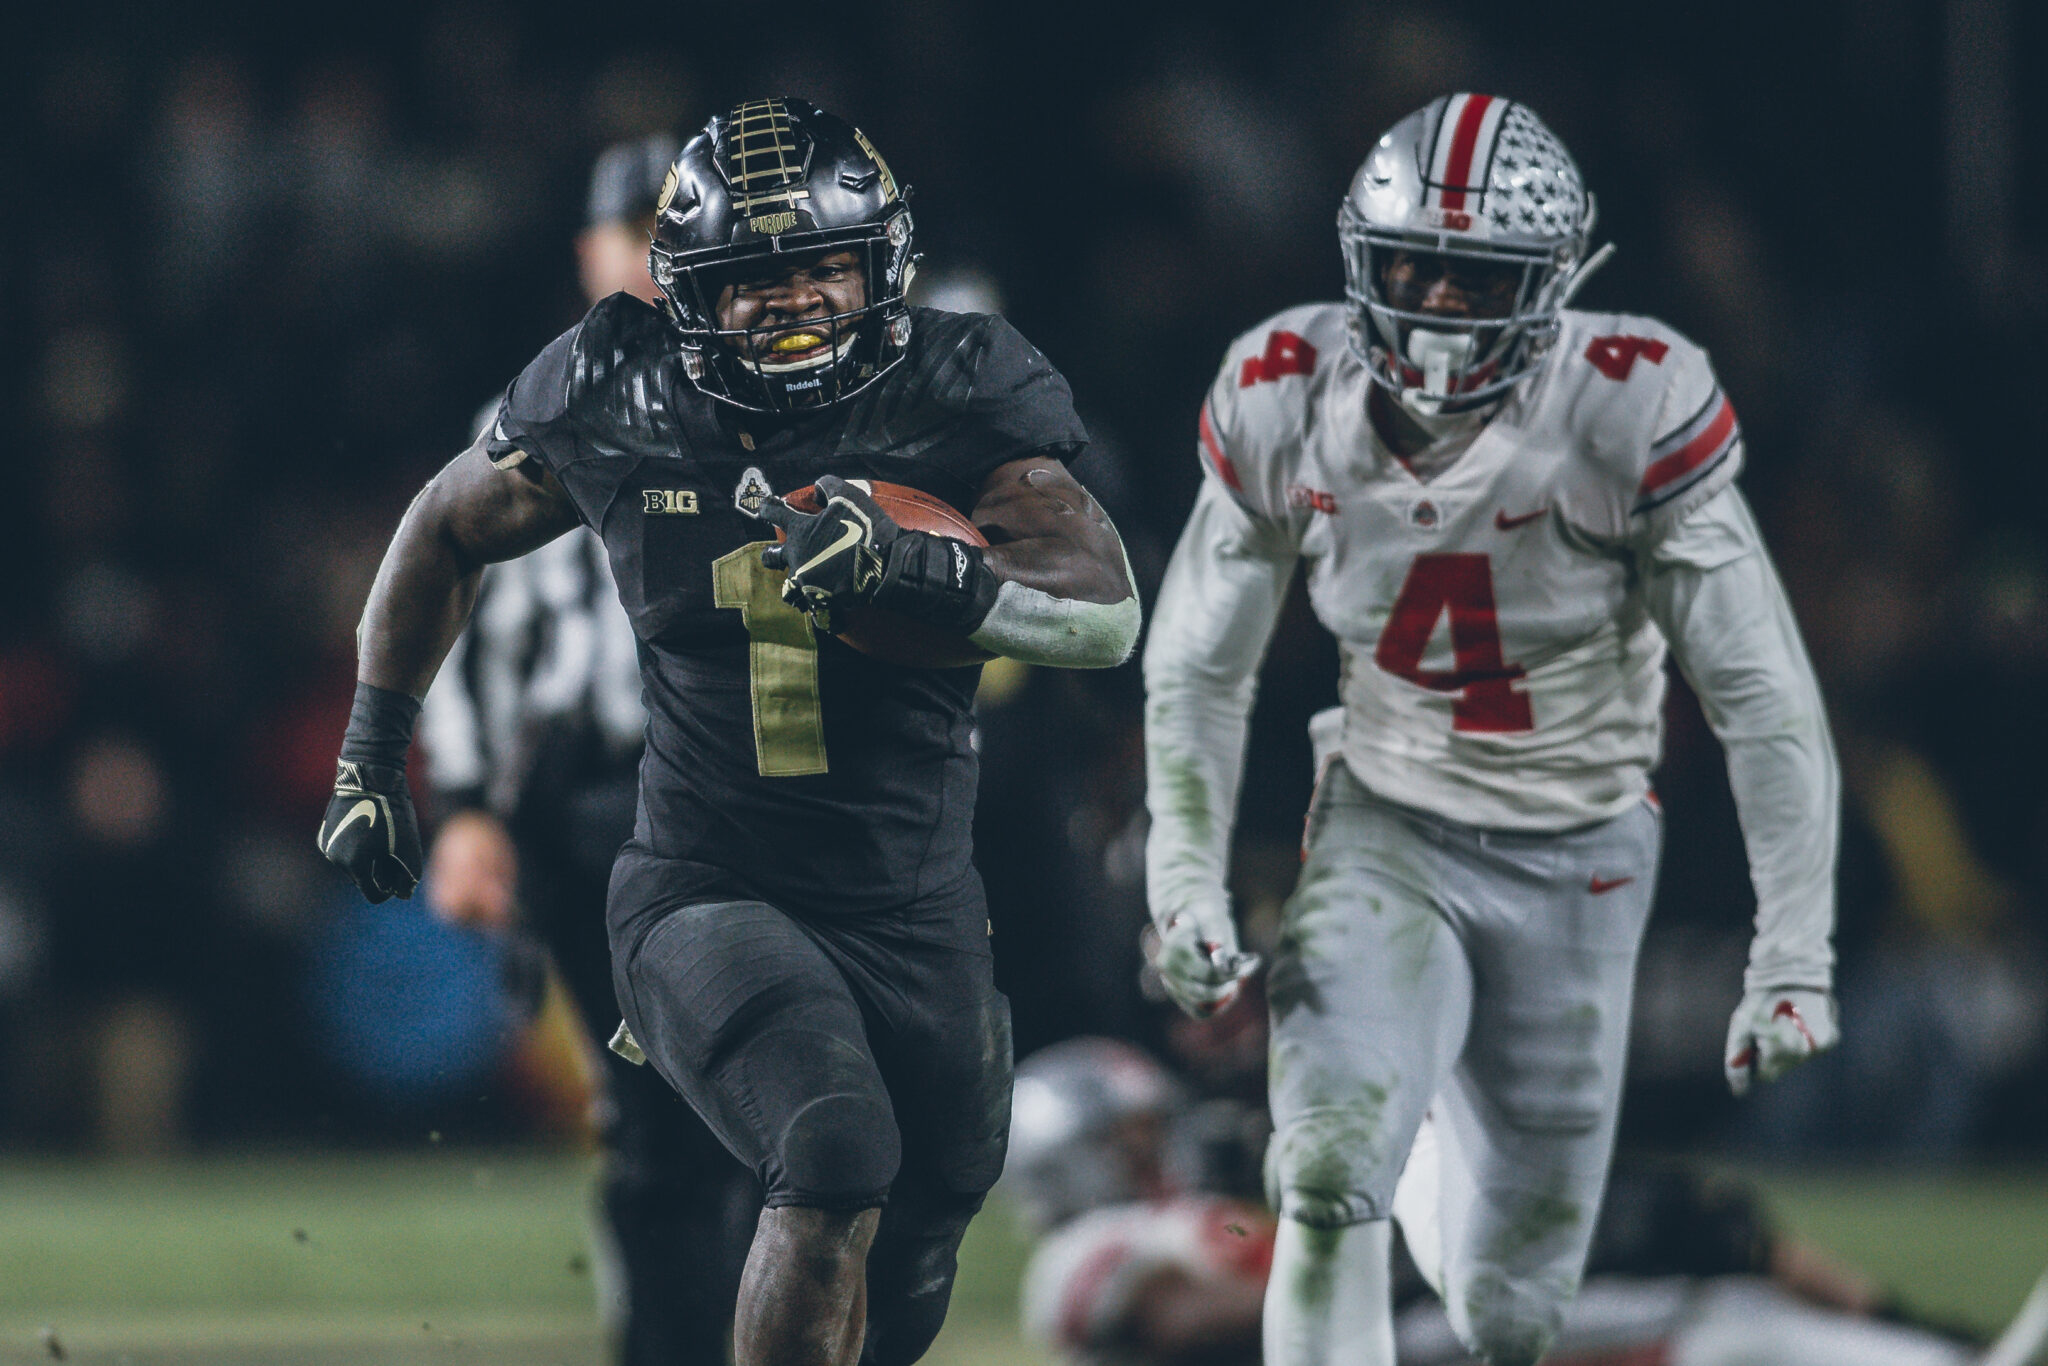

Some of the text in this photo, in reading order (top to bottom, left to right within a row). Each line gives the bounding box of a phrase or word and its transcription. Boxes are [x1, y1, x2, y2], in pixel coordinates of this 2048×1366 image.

[750, 211, 797, 235] PURDUE
[1240, 330, 1317, 388] 4
[1584, 334, 1669, 381] 4
[712, 540, 828, 777] 1
[1375, 553, 1535, 732] 4
